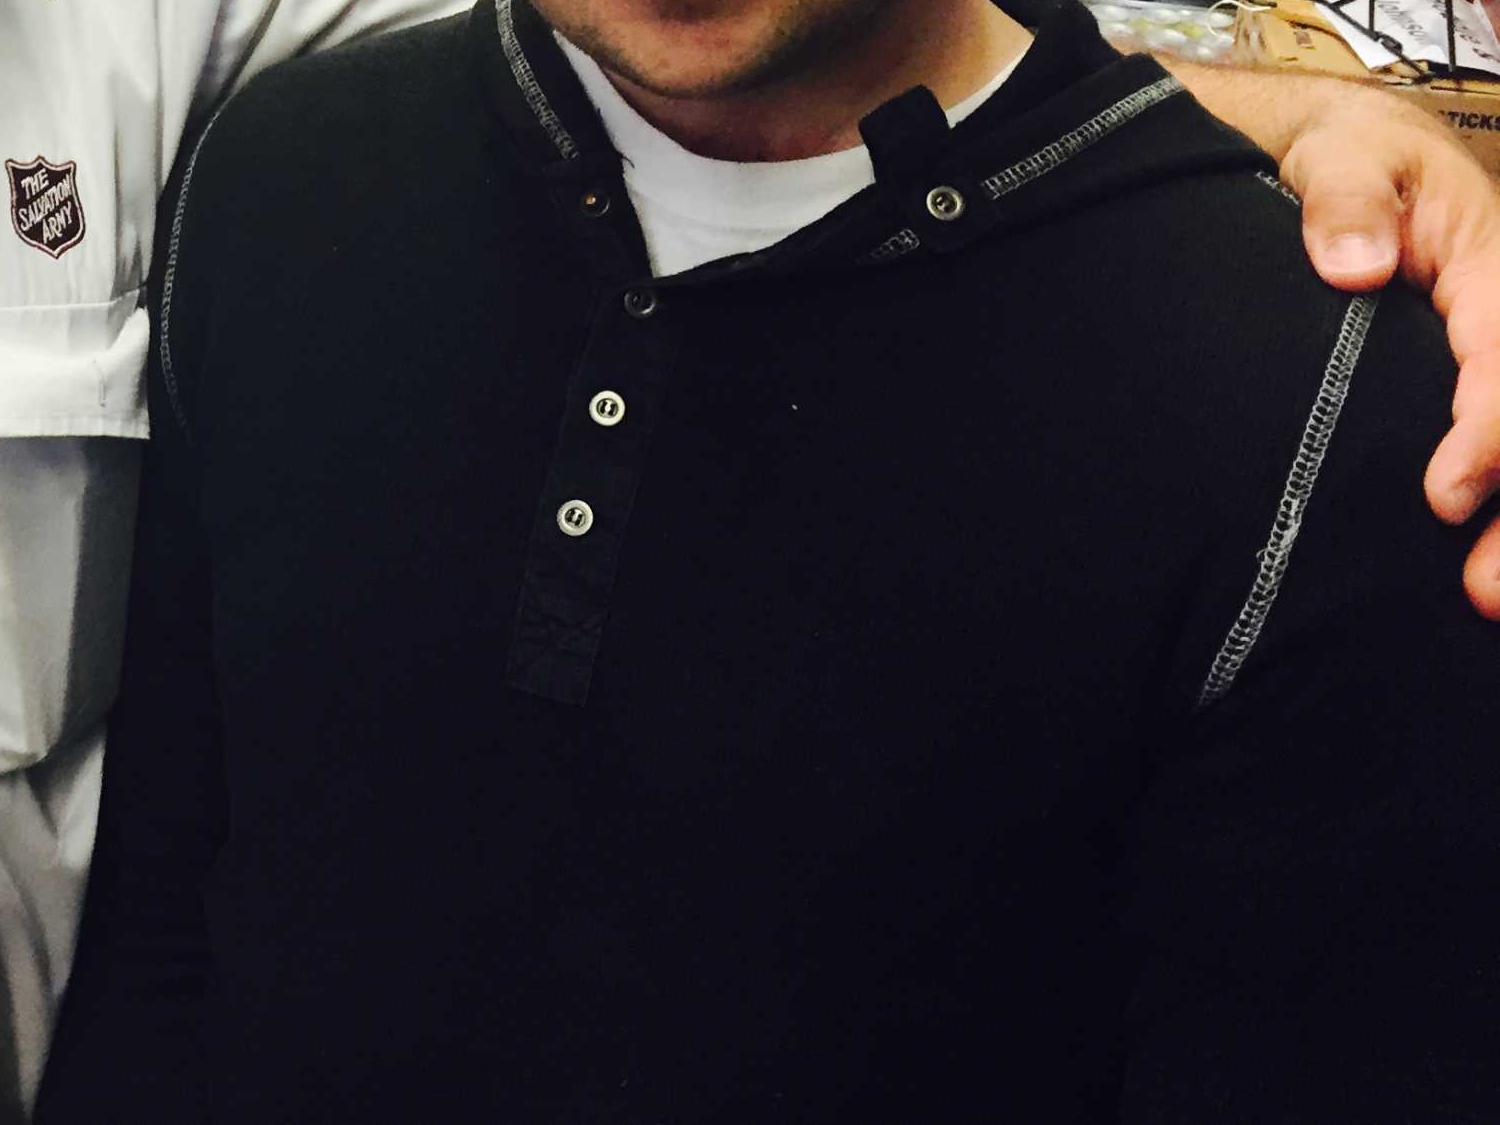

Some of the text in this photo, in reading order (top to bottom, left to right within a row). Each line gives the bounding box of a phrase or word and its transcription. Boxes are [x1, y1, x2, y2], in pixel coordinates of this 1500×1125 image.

[19, 173, 73, 231] SALVATION
[21, 168, 49, 199] THE
[42, 201, 72, 244] ARMY
